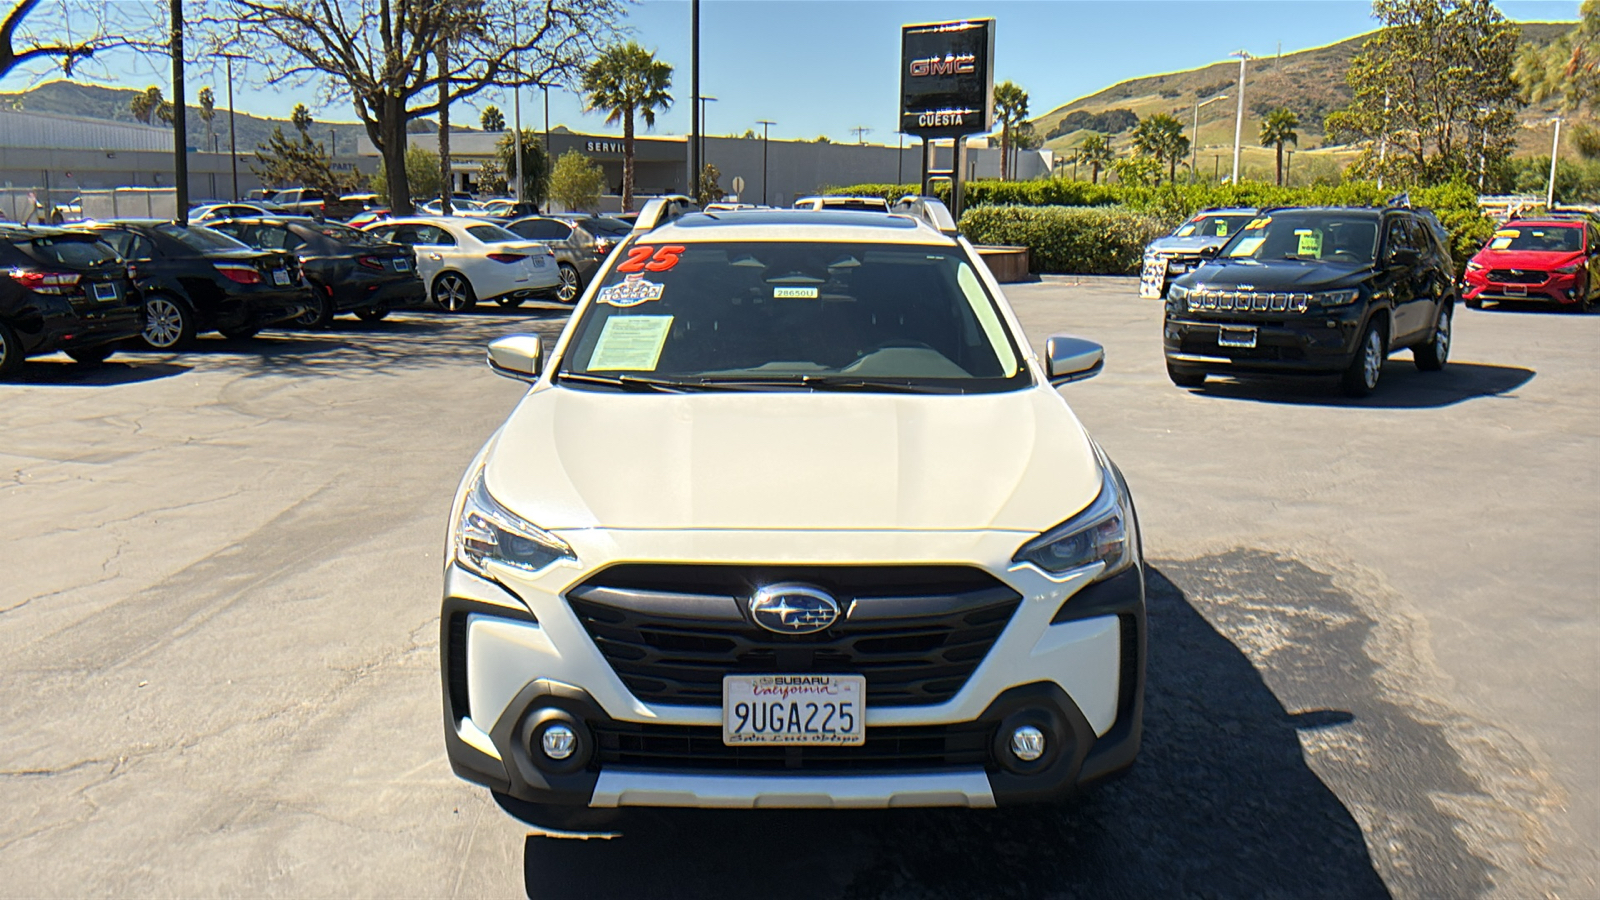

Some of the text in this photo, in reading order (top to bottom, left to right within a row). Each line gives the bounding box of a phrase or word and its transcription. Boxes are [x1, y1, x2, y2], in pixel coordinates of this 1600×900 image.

[910, 54, 975, 76] GMC
[918, 114, 963, 127] CUESTA
[587, 141, 635, 153] SERVI
[332, 162, 356, 171] PART
[616, 246, 686, 272] 25
[774, 676, 830, 685] SUBARU
[752, 685, 839, 700] California
[734, 702, 854, 734] 9UGA225
